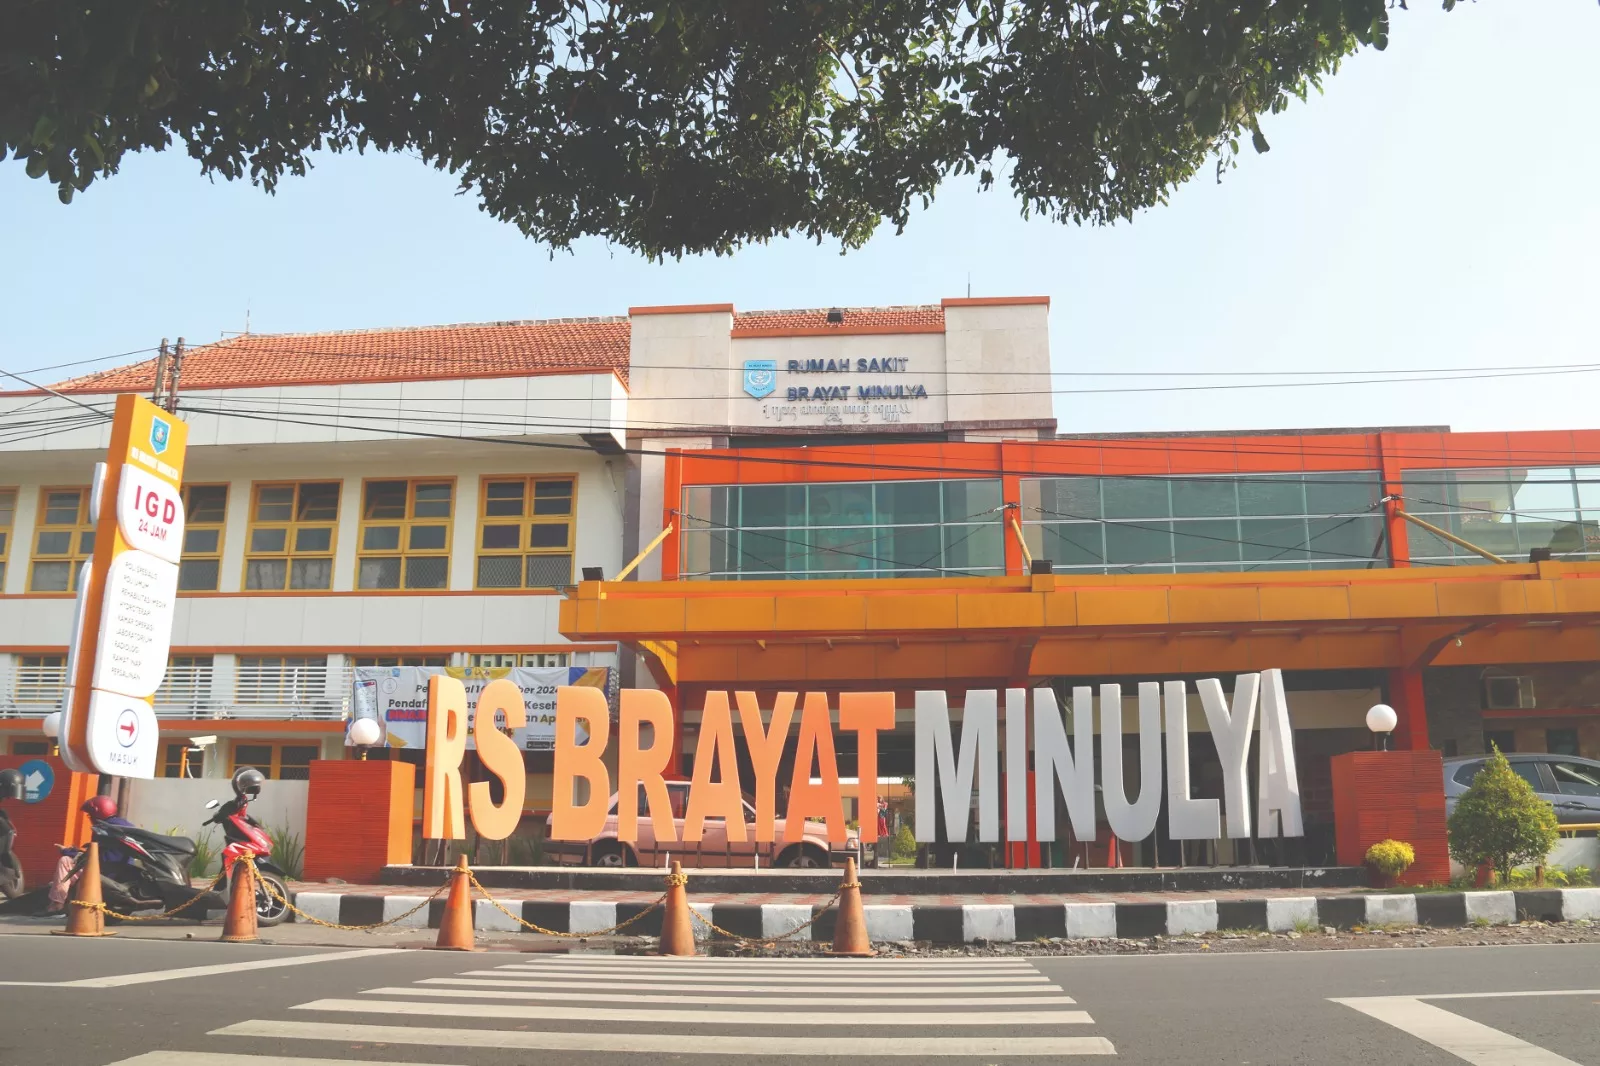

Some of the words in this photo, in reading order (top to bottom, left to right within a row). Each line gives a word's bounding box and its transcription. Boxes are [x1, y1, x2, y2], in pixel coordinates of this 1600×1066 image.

[787, 358, 850, 374] RUMAH
[857, 356, 909, 373] SAKIT
[787, 385, 851, 401] BRAYAT
[857, 384, 928, 400] MINULYA
[134, 485, 176, 525] IGD
[138, 518, 148, 532] 24
[150, 524, 167, 541] JAM
[109, 751, 138, 765] MASUK
[423, 674, 526, 840] RS
[552, 685, 895, 842] BRAYAT
[915, 668, 1304, 842] MINULYA
